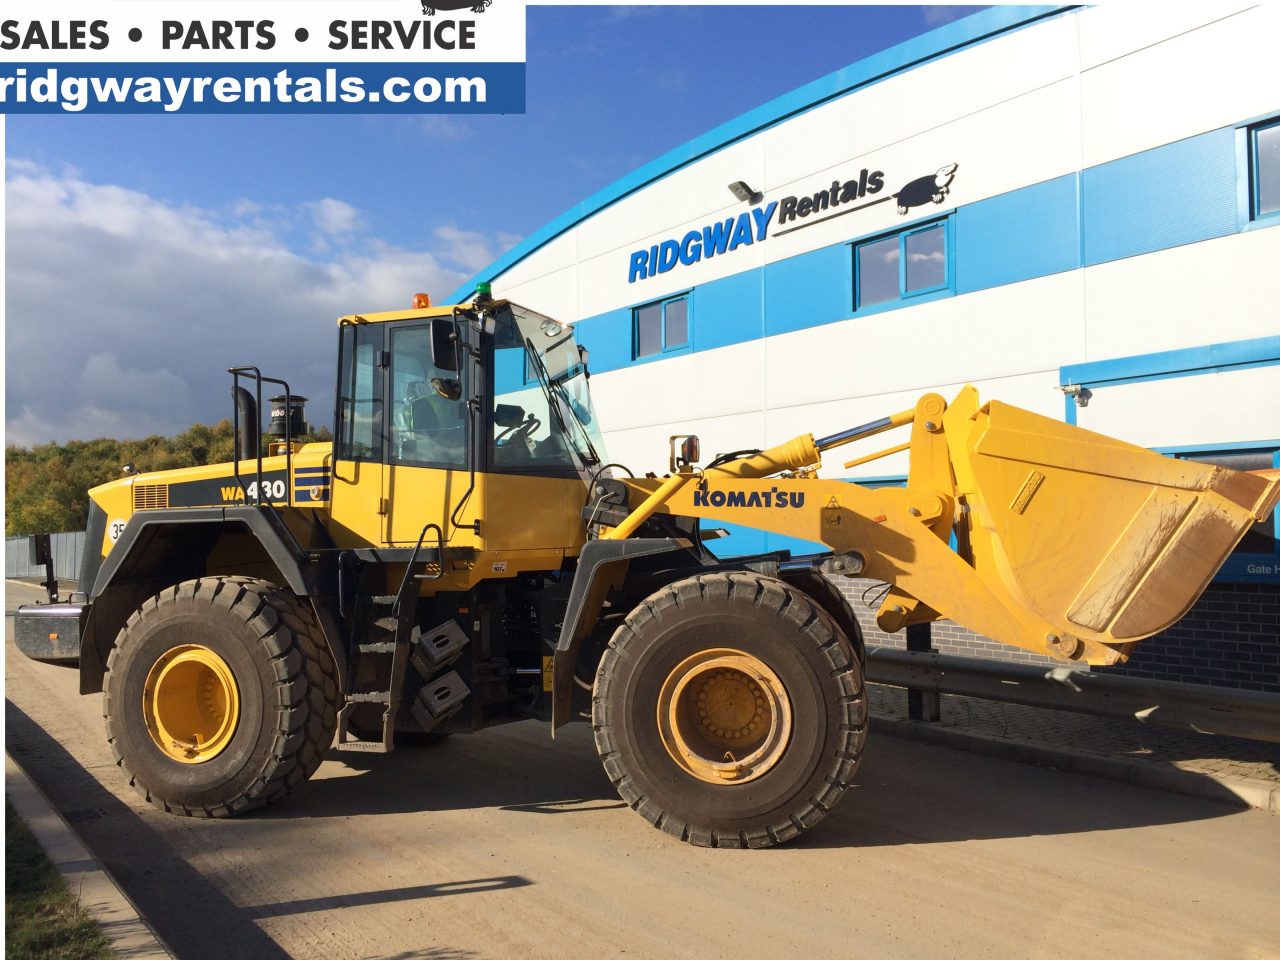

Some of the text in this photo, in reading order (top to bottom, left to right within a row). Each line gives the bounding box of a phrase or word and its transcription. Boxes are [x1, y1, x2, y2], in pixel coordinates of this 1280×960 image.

[628, 168, 885, 283] RIDGWAY Rentals
[693, 487, 805, 508] KOMATSU
[1247, 564, 1272, 575] Gate
